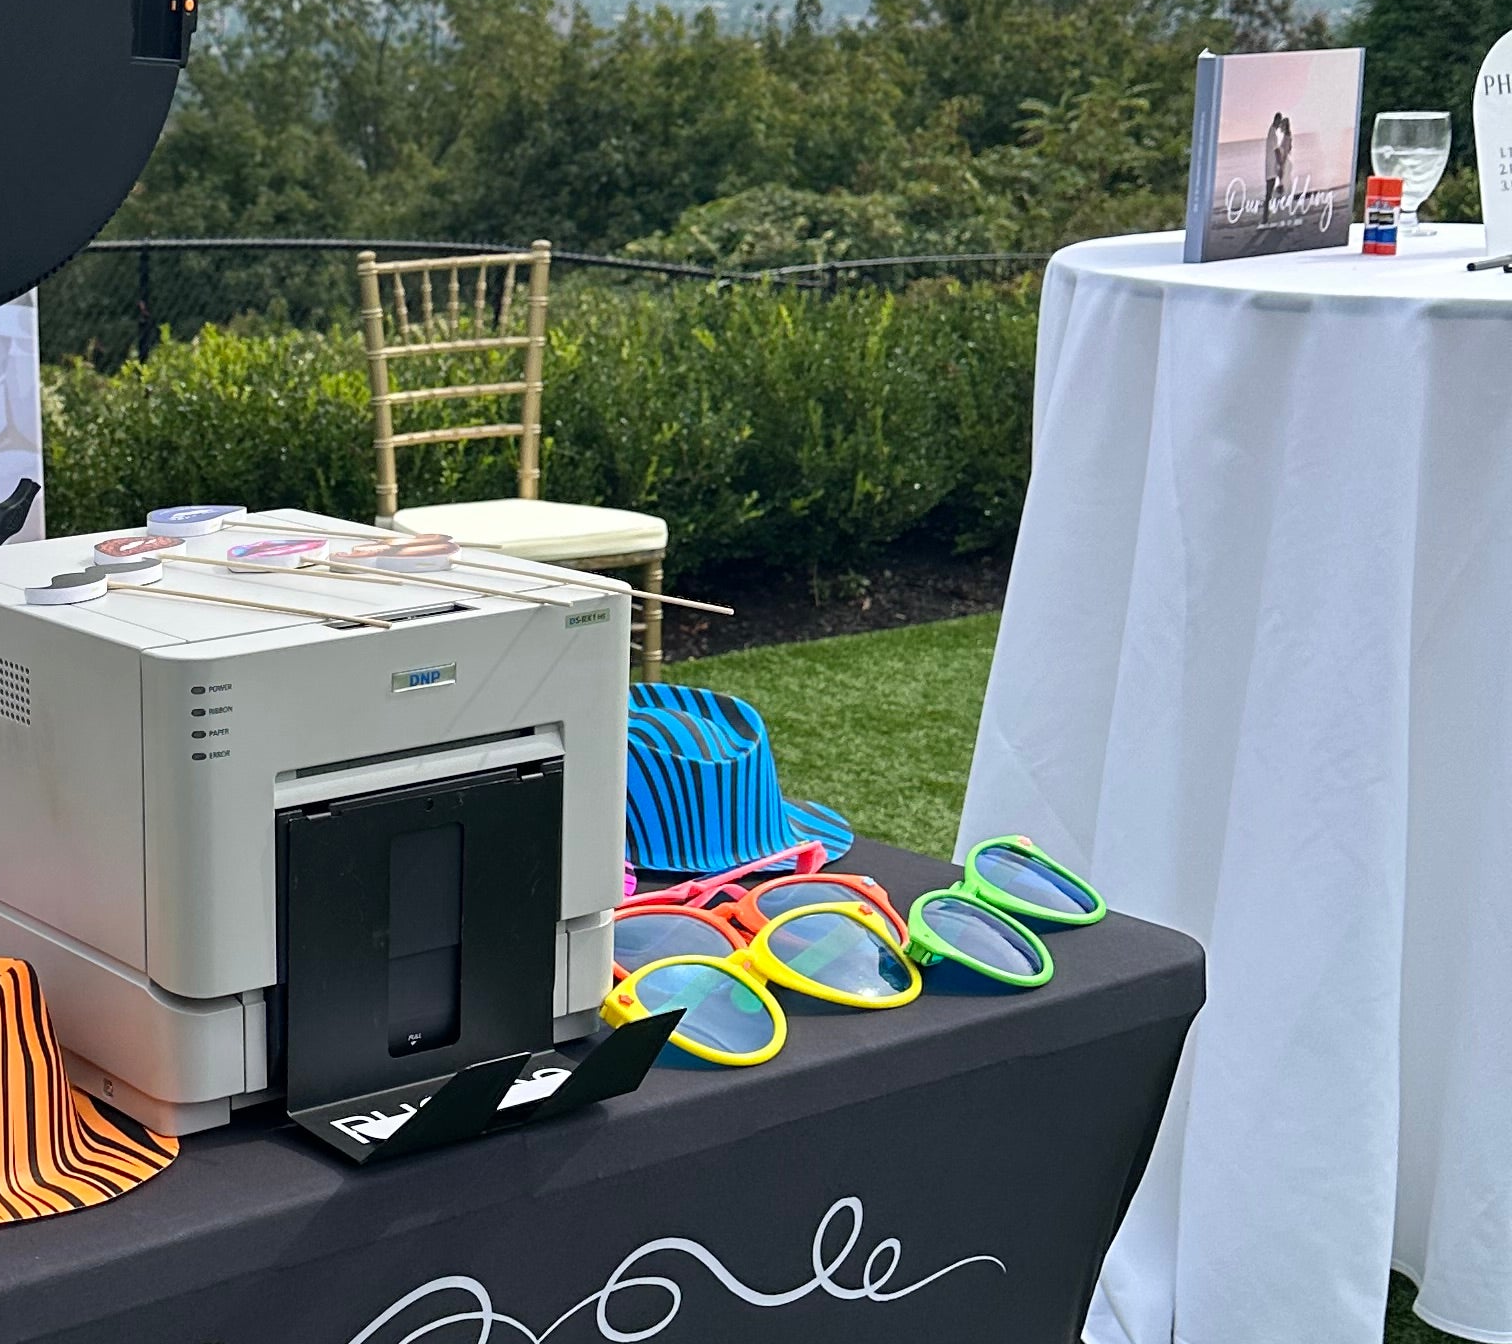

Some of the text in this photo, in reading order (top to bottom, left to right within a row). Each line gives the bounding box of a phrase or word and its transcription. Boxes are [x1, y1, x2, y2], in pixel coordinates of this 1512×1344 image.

[1225, 174, 1334, 233] Our wedding
[409, 670, 441, 687] DNP
[208, 683, 232, 693] POWER
[208, 705, 233, 716] RIBBON
[208, 728, 229, 737] PAPER
[208, 749, 231, 759] ERROR
